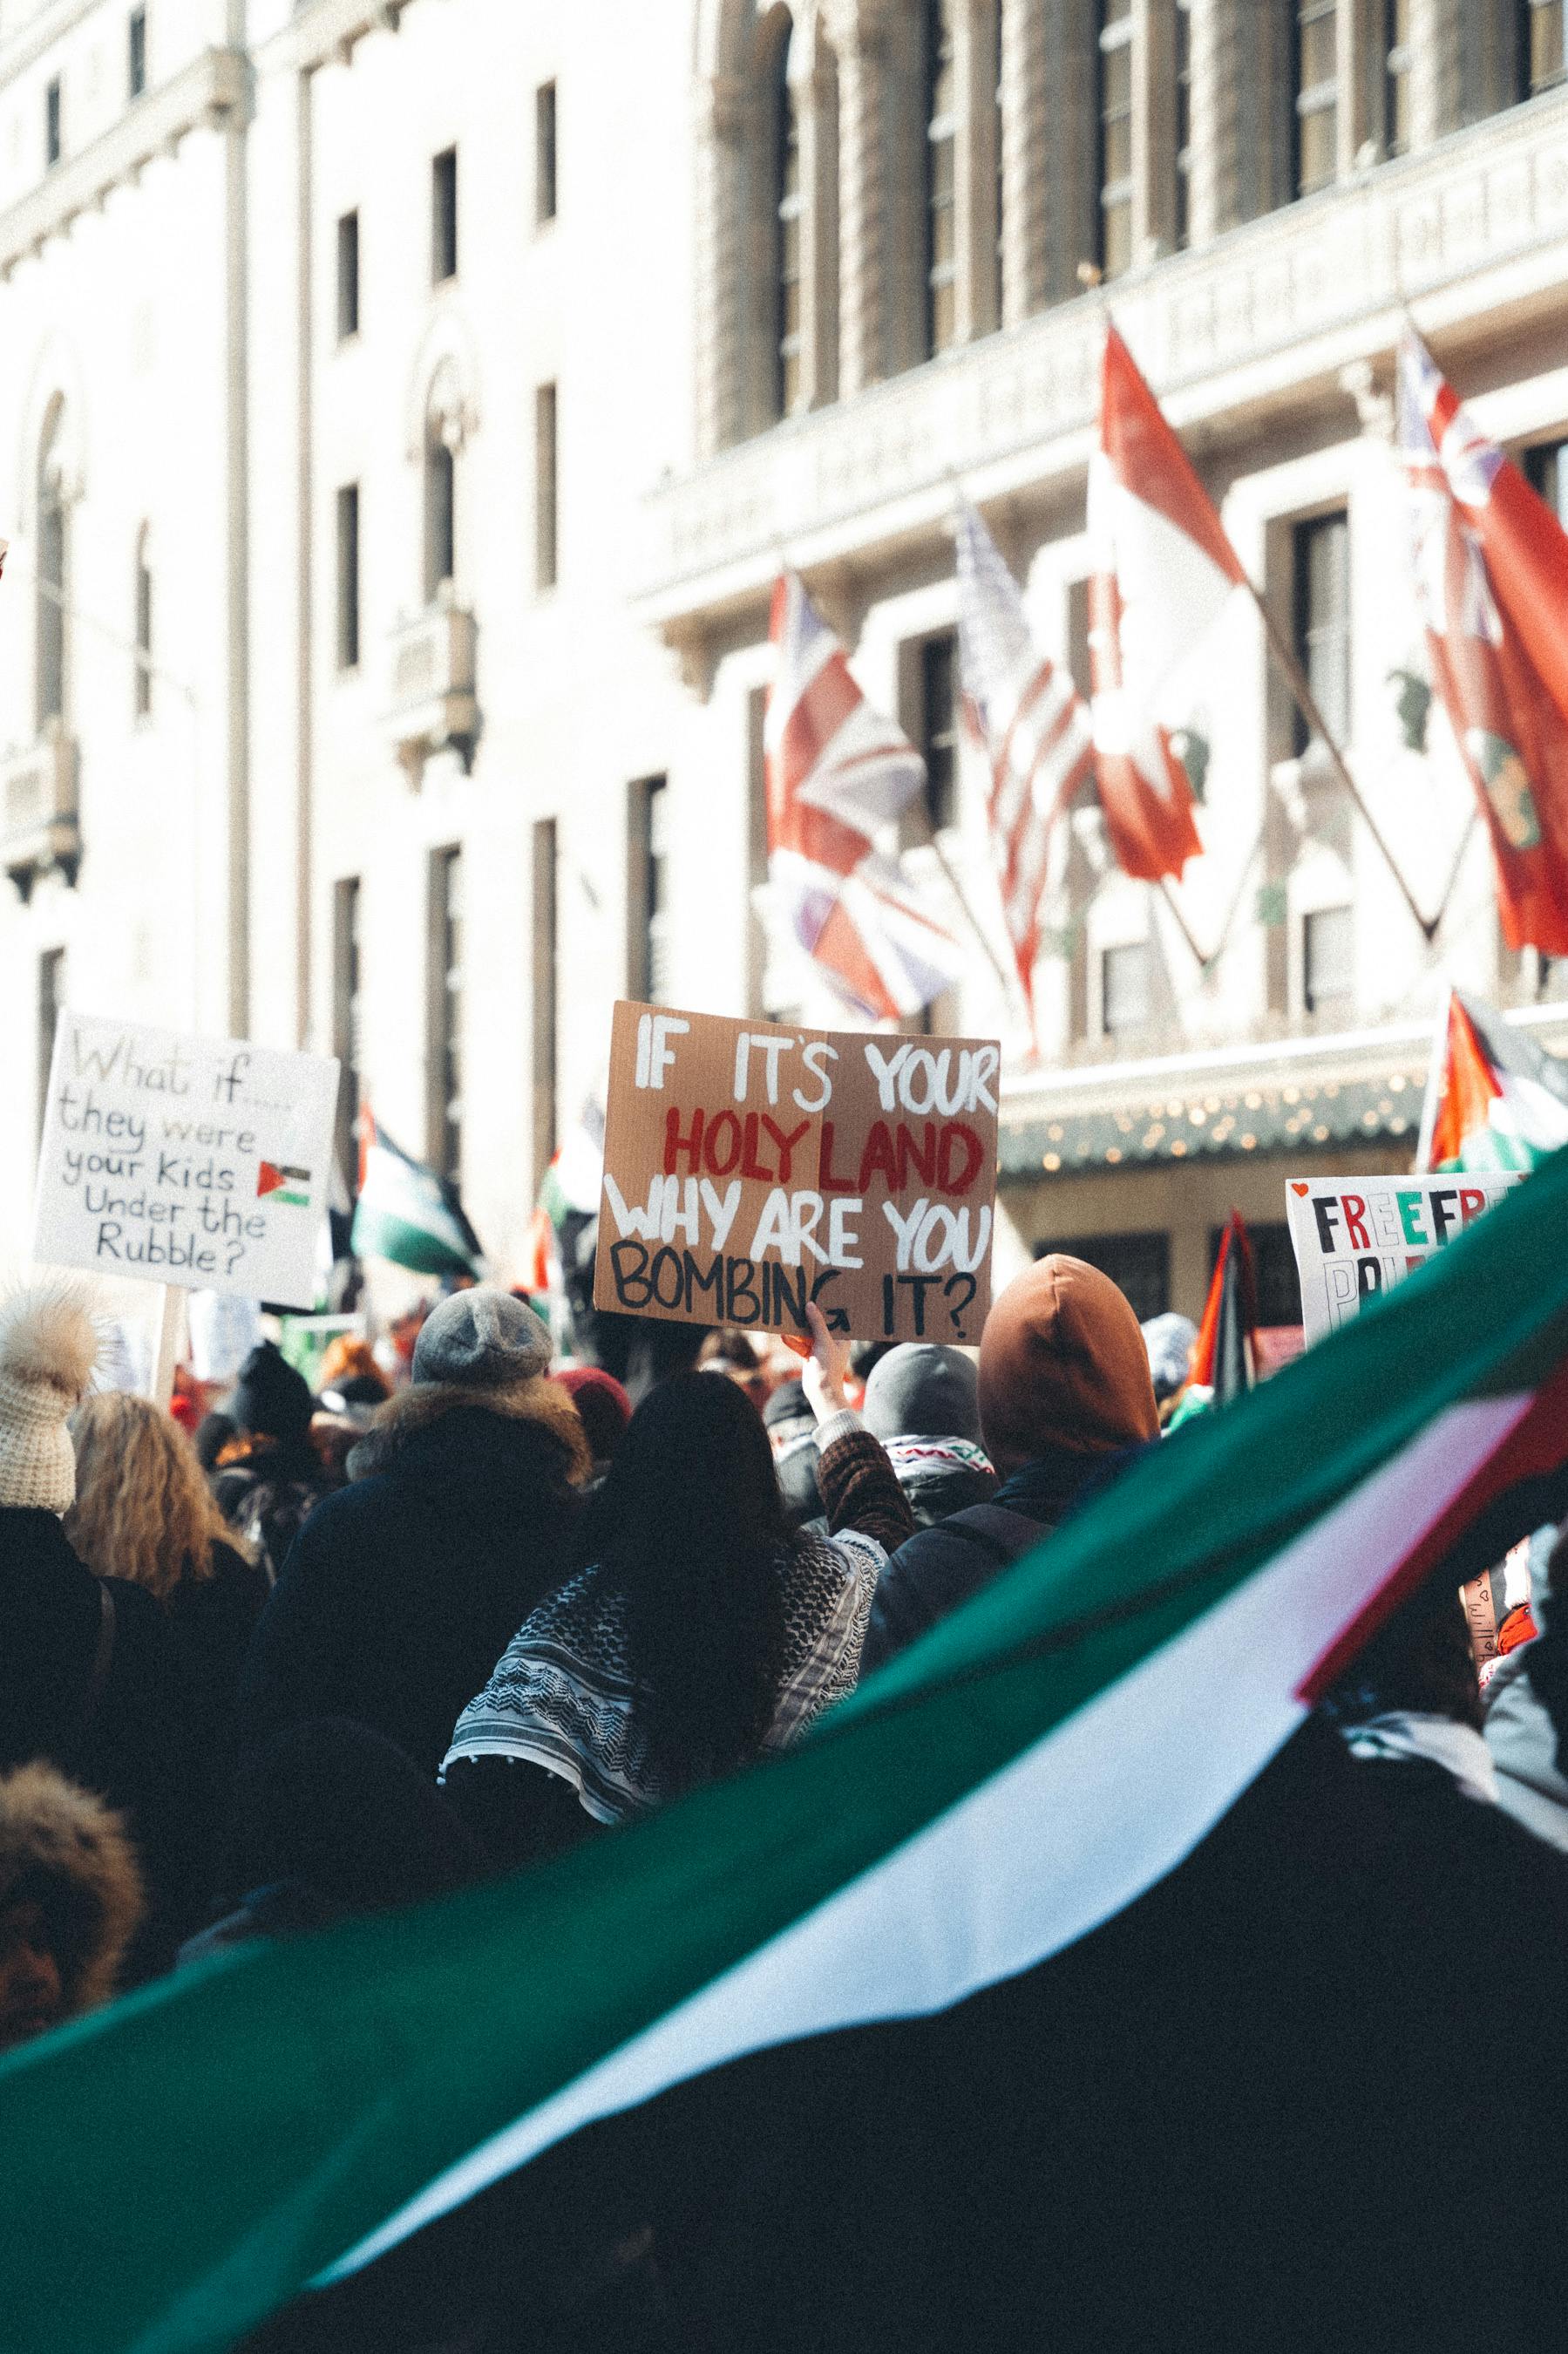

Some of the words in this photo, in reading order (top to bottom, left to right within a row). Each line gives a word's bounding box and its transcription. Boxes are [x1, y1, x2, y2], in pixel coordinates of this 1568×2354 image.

[73, 1029, 189, 1095] What
[635, 1013, 690, 1089] IF
[734, 1031, 838, 1112] IT'S
[865, 1043, 999, 1117] YOUR
[59, 1085, 145, 1154] they
[163, 1119, 255, 1153] were
[663, 1106, 811, 1184] HOLY
[818, 1119, 984, 1196] LAND
[62, 1149, 144, 1187] your
[85, 1185, 185, 1222] Under
[197, 1197, 267, 1239] the
[603, 1174, 742, 1251] WHY
[750, 1187, 864, 1269] ARE
[882, 1198, 991, 1273] YOU
[97, 1222, 245, 1276] Rubble?
[610, 1239, 851, 1332] BOMBING
[882, 1272, 977, 1339] IT?
